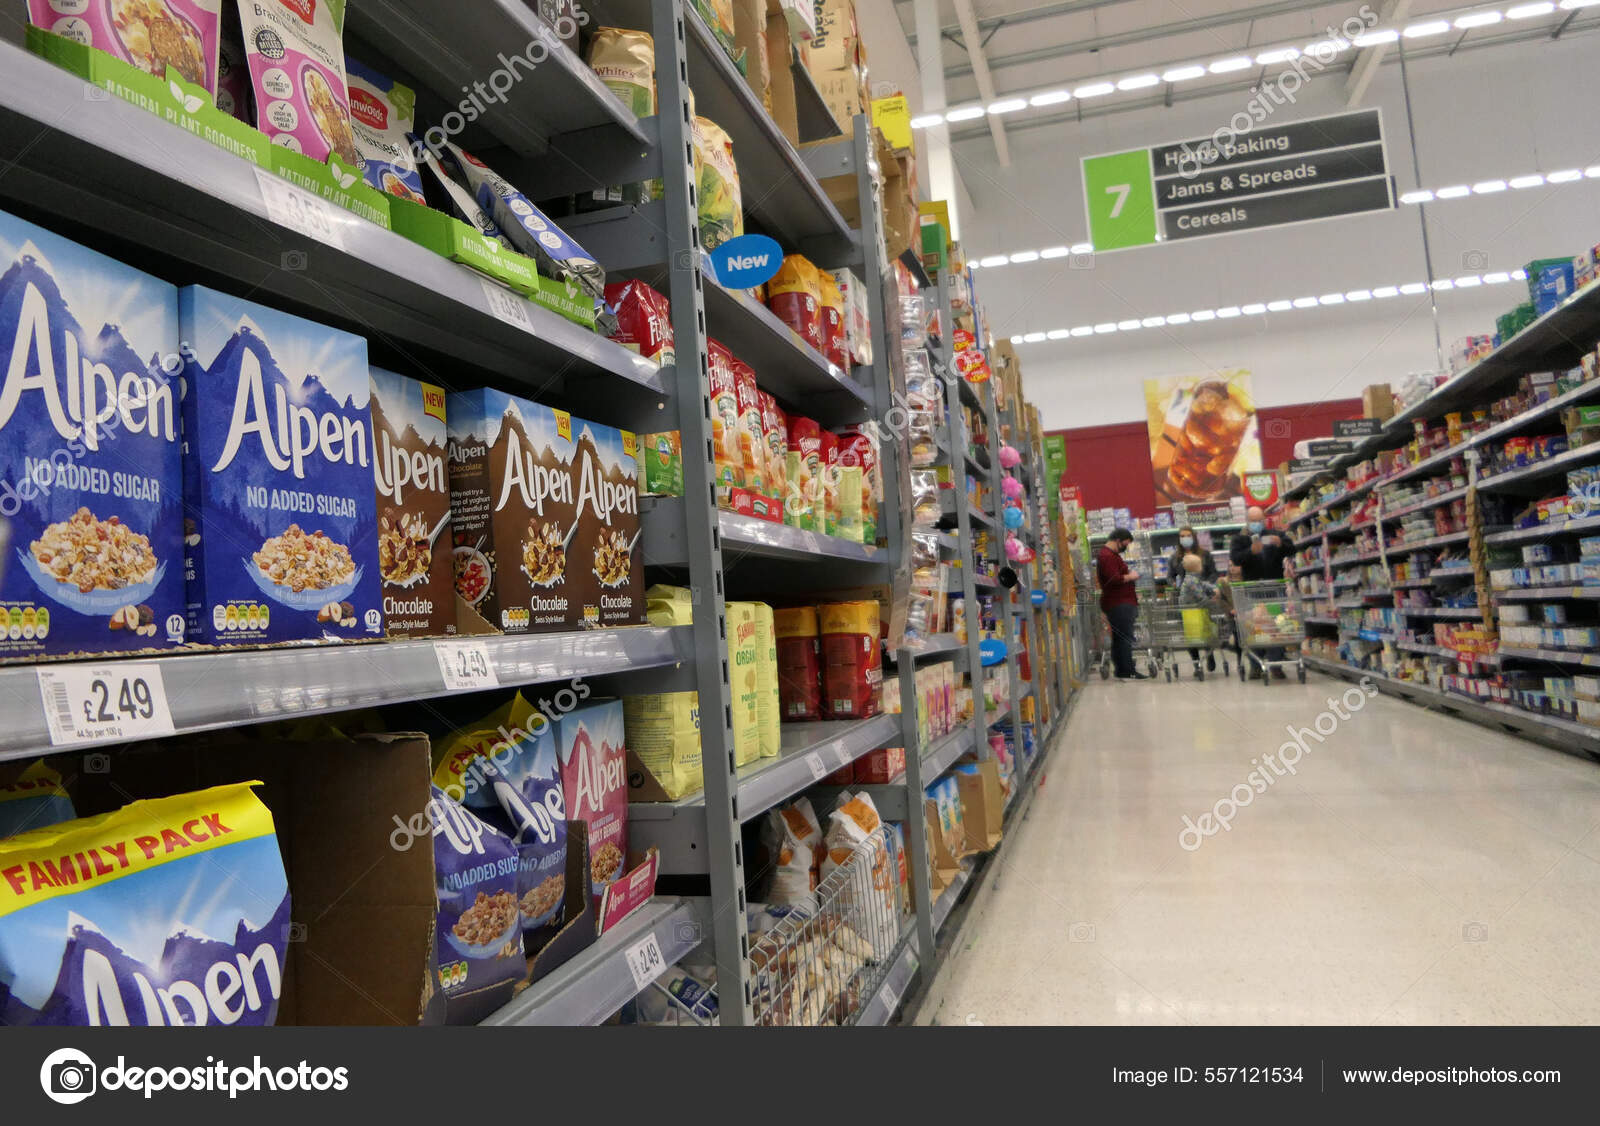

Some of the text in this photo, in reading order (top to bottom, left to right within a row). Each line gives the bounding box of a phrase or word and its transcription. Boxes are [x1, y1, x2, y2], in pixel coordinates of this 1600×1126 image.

[105, 79, 258, 163] NATURAL PLANT GOODNESS
[1167, 164, 1318, 200] Jams & Spreads
[1105, 183, 1131, 218] 7
[1177, 207, 1247, 230] Cereals
[727, 253, 769, 272] New
[0, 281, 177, 451] Alpen
[211, 346, 369, 479] Alpen
[425, 391, 444, 409] NEW
[557, 415, 570, 431] NEW
[448, 441, 486, 464] Alpen
[25, 456, 160, 503] NO ADDED SUGAR
[495, 428, 573, 516] Alpen
[577, 449, 637, 526] Alpen
[247, 486, 357, 519] NO ADDED SUGAR
[368, 611, 378, 625] 12
[383, 596, 433, 615] Chocolate
[531, 595, 568, 611] Chocolate
[600, 594, 632, 609] Chocolate
[170, 617, 181, 632] 12
[84, 678, 154, 722] £2.49
[573, 740, 626, 820] Alpen
[1, 813, 234, 896] FAMILY PACK
[462, 863, 497, 887] ADDED
[498, 855, 519, 875] SUG
[83, 942, 281, 1026] Alpen
